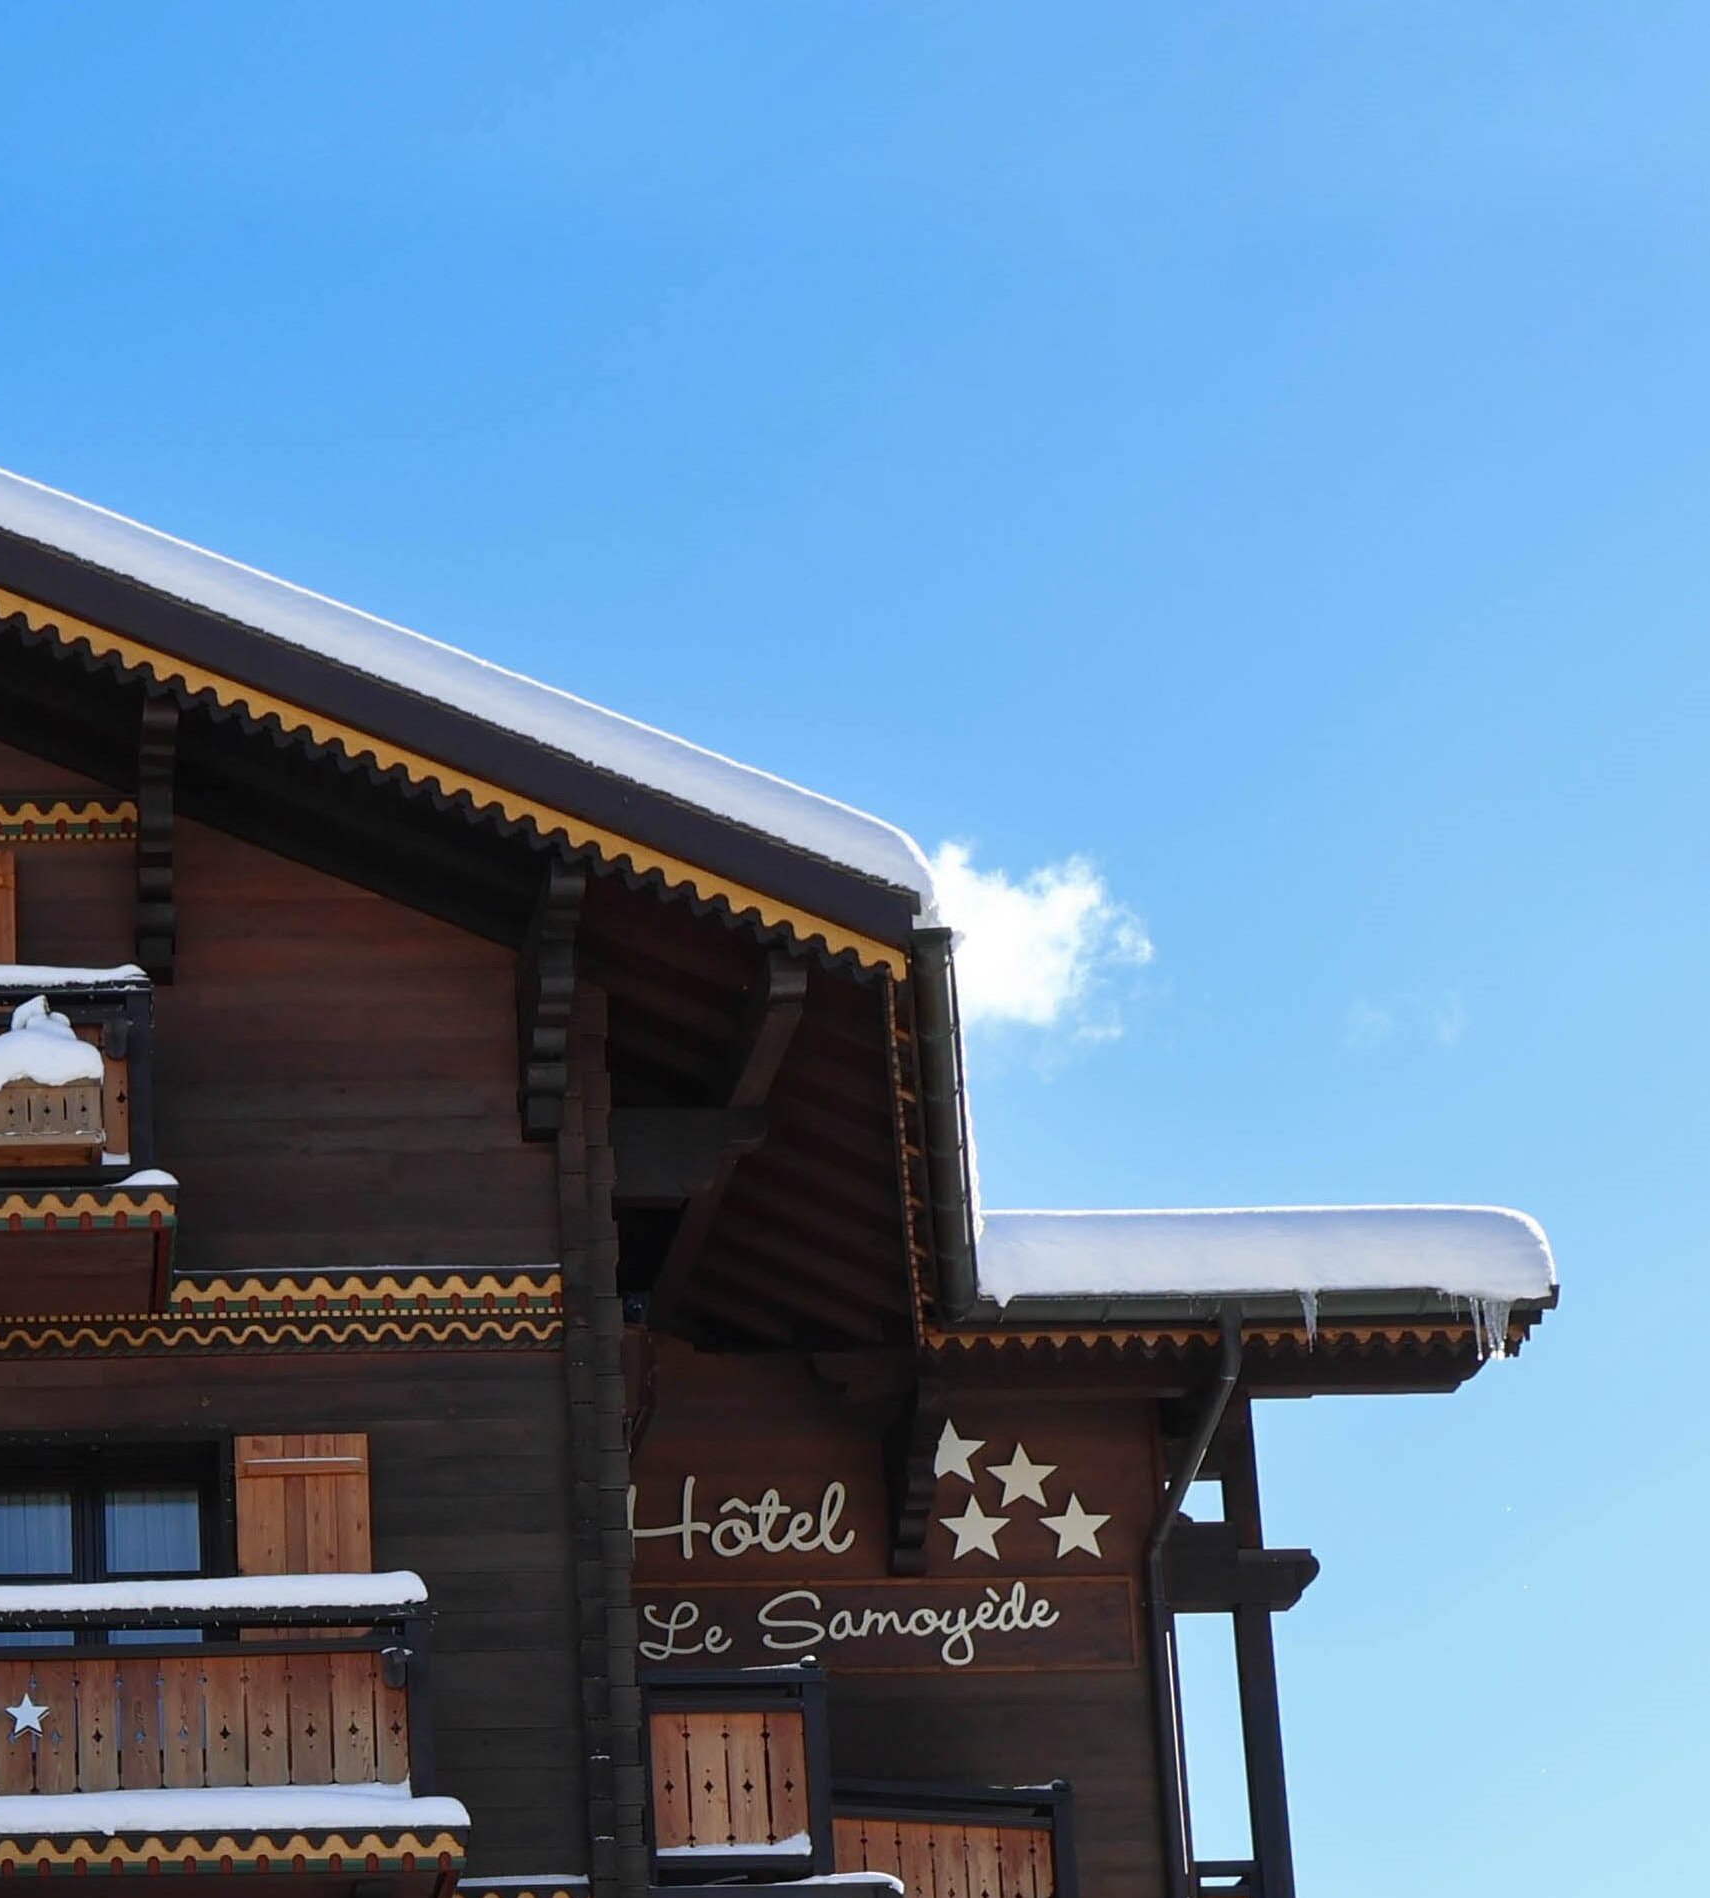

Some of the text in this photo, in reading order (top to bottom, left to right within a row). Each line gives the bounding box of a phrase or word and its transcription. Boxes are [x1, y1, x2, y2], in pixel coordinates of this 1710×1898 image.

[626, 1475, 856, 1560] Hôtel
[638, 1581, 1060, 1666] Le Samoyède
